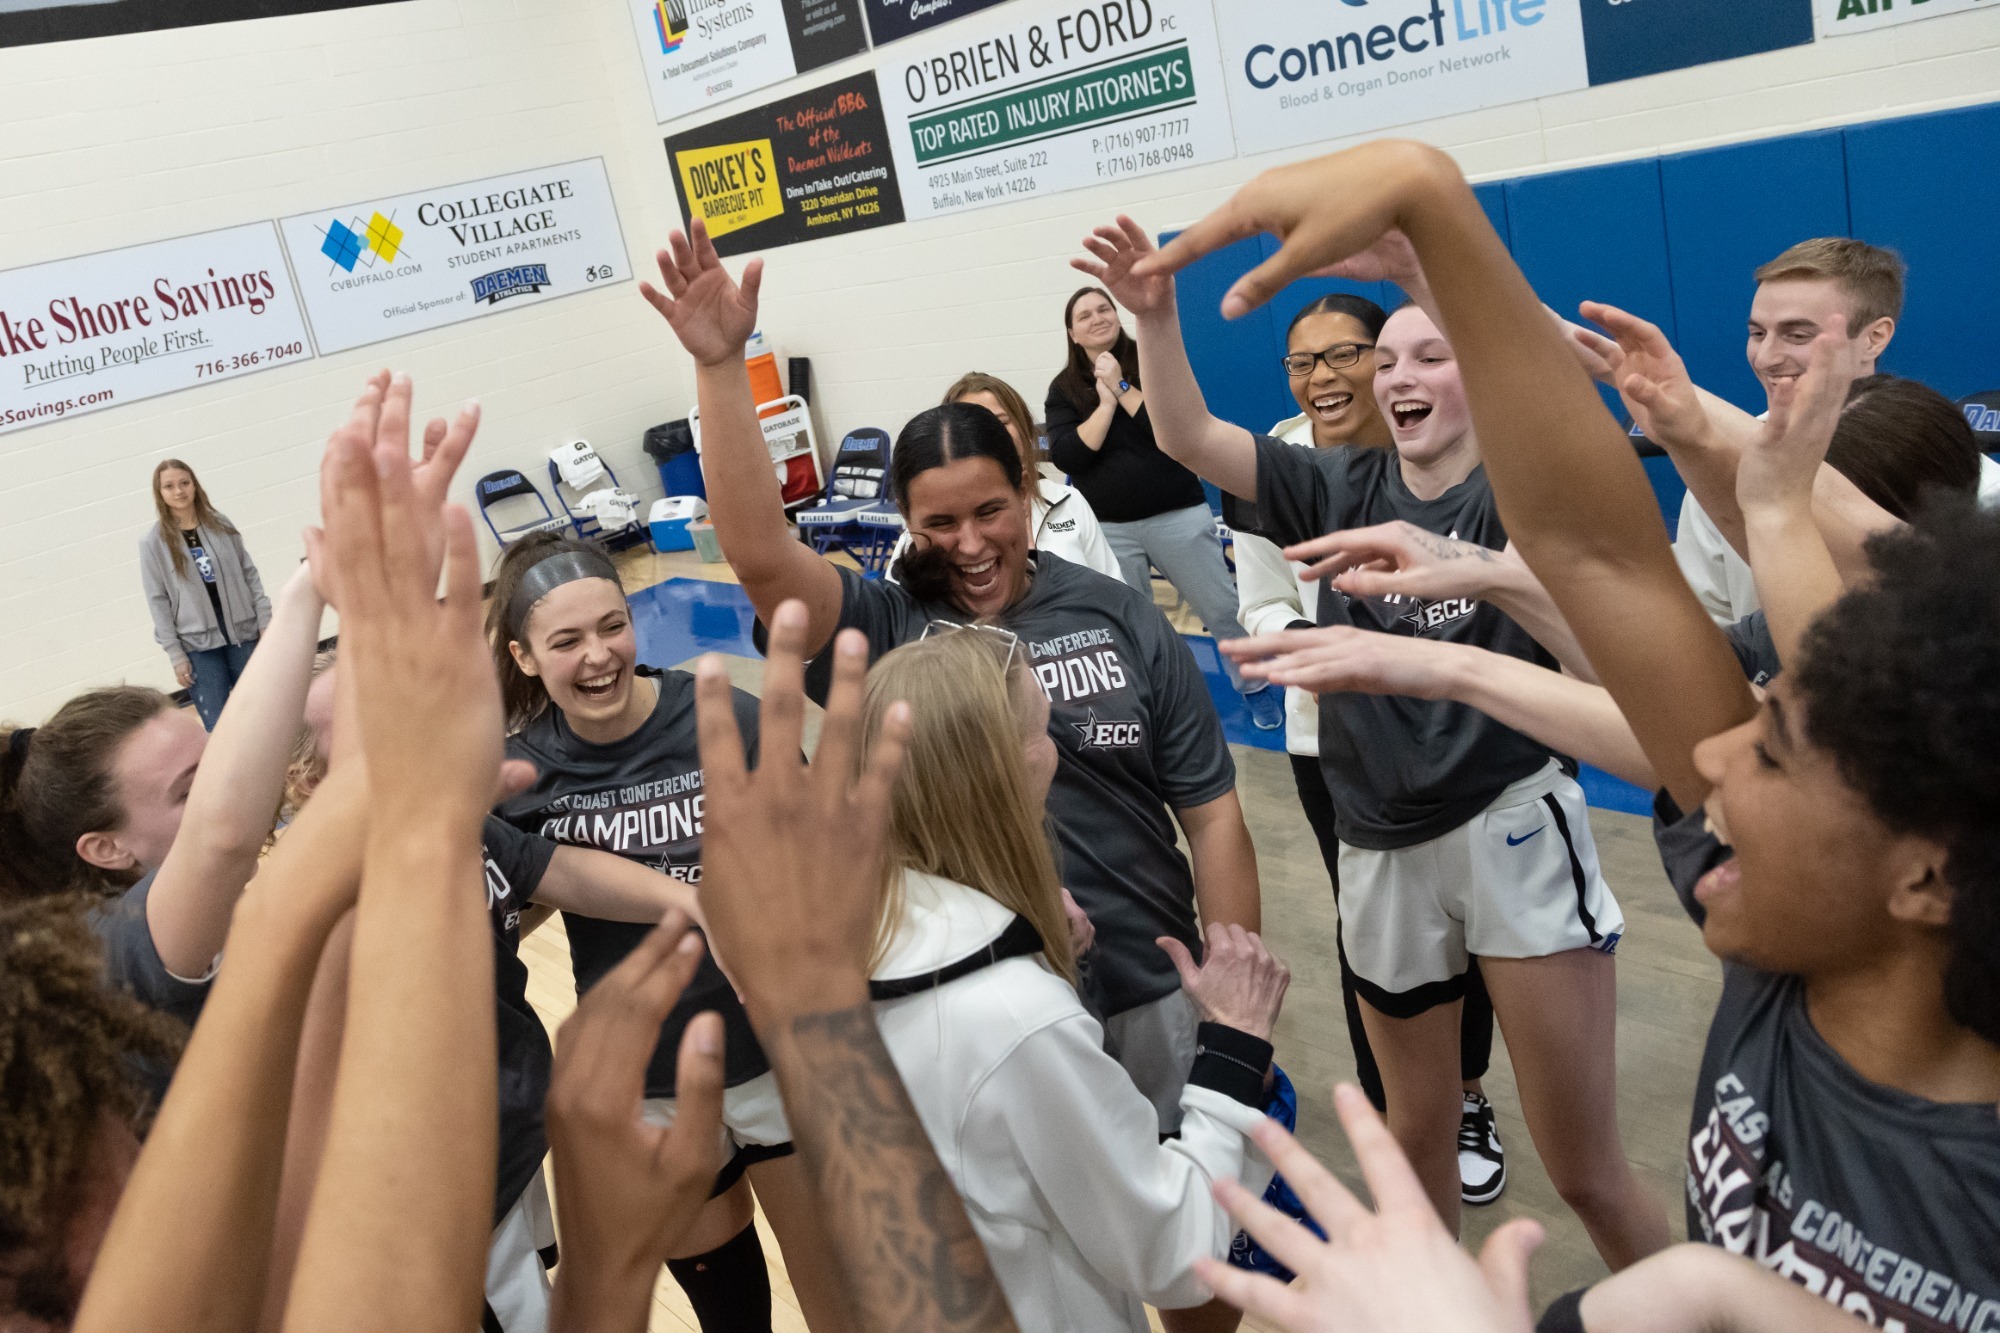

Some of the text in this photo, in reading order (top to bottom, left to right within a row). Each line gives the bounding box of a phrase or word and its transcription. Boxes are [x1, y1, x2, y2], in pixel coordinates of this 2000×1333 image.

[696, 2, 754, 40] Systems
[662, 70, 668, 80] A
[680, 54, 710, 74] Document
[709, 44, 738, 62] Solutions
[737, 33, 767, 52] Company
[905, 0, 1177, 103] O'BRIEN & FORD PC
[1279, 45, 1511, 110] Blood & Organ Donor Network
[776, 116, 794, 135] The
[796, 100, 837, 129] Official
[915, 59, 1188, 153] TOP RATED INJURY ATTORNEYS
[808, 125, 840, 149] of the
[1092, 118, 1190, 154] P: (716) 907-7777
[689, 148, 766, 200] DICKEY'S
[788, 140, 872, 173] Daemen Wildcats
[928, 151, 1048, 189] 4925 Main Street, Suite 222
[1096, 142, 1195, 177] F: (716) 768-0948
[786, 166, 888, 199] Dine In/Take Out/Catering
[800, 186, 878, 212] 3220 Sheridan Drive
[932, 176, 1036, 210] Buffalo, New York 14226
[417, 179, 574, 226] COLLEGIATE
[703, 192, 748, 219] BARBECUE
[748, 188, 764, 208] PIT
[806, 201, 880, 226] Amherst, NY 14226
[450, 210, 557, 247] VILLAGE
[448, 229, 581, 268] STUDENT APARTMENTS
[330, 264, 423, 292] CVBUFFALO.COM
[472, 264, 549, 302] DAEMEN
[494, 285, 534, 301] ATHLETICS
[0, 268, 275, 357] ke Shore Savings
[383, 292, 467, 319] Official Sponsor of:
[23, 327, 210, 384] Putting People First.
[195, 342, 303, 377] 716-366-7040
[763, 417, 800, 433] GATORADE
[1029, 628, 1114, 658] CONFERENCE
[1029, 650, 1127, 702] PIONS
[1093, 721, 1141, 745] ECC
[573, 789, 616, 810] COAST
